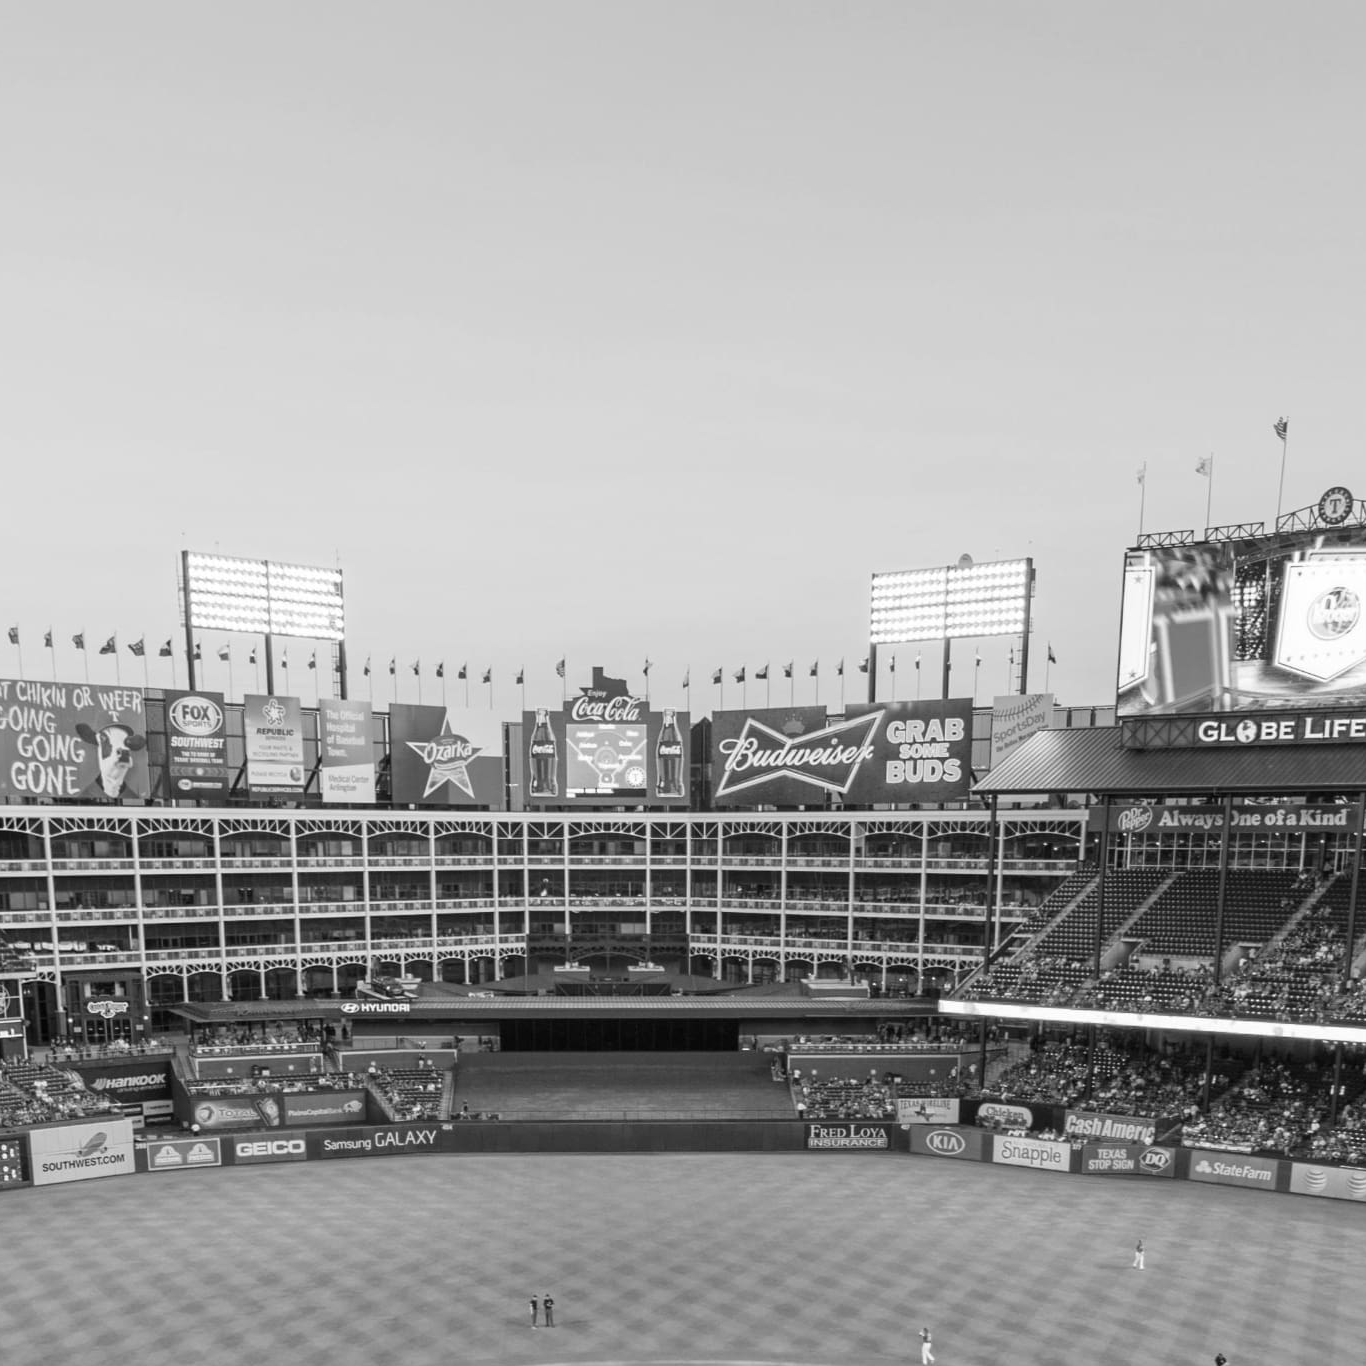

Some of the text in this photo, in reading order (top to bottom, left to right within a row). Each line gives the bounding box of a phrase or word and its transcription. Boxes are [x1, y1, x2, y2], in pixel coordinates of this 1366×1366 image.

[16, 681, 66, 708] CHIKIN
[73, 687, 94, 711] OR
[98, 690, 141, 714] WEER
[587, 690, 607, 698] Enjoy
[181, 704, 210, 720] FOX
[326, 710, 364, 721] The Official
[182, 719, 212, 728] SPORTS
[326, 722, 355, 734] Hospital
[886, 718, 964, 743] GRAB
[994, 712, 1045, 743] SportsDay
[1198, 719, 1295, 744] GLOBE
[1304, 717, 1366, 739] LIFE
[256, 728, 294, 736] REPUBLIC
[326, 735, 334, 744] of
[17, 733, 85, 763] GOING
[171, 736, 224, 749] SOUTHWEST
[424, 741, 472, 763] Ozarka
[719, 737, 874, 771] Budweiser
[899, 742, 950, 760] SOME
[11, 762, 80, 796] GONE
[886, 758, 962, 784] BUDS
[1121, 811, 1150, 831] Pepper
[1158, 810, 1223, 829] Always
[1264, 809, 1285, 826] of
[1286, 813, 1297, 826] a
[1299, 809, 1346, 826] Kind
[361, 1003, 410, 1012] HYUNDAI
[218, 1109, 256, 1118] TOTAL
[986, 1106, 1024, 1120] Chicken
[810, 1124, 886, 1138] FRED LOYA
[1066, 1115, 1102, 1136] Cash
[236, 1140, 305, 1157] GEICO
[324, 1130, 436, 1151] Samsung GALAXY
[810, 1138, 885, 1147] INSURANCE
[934, 1135, 958, 1150] KIA
[1001, 1141, 1061, 1166] Snapple
[1097, 1149, 1127, 1159] TEXAS
[1146, 1153, 1165, 1167] DQ
[42, 1154, 125, 1172] SOUTHWEST.COM
[1089, 1159, 1134, 1170] STOP SIGN
